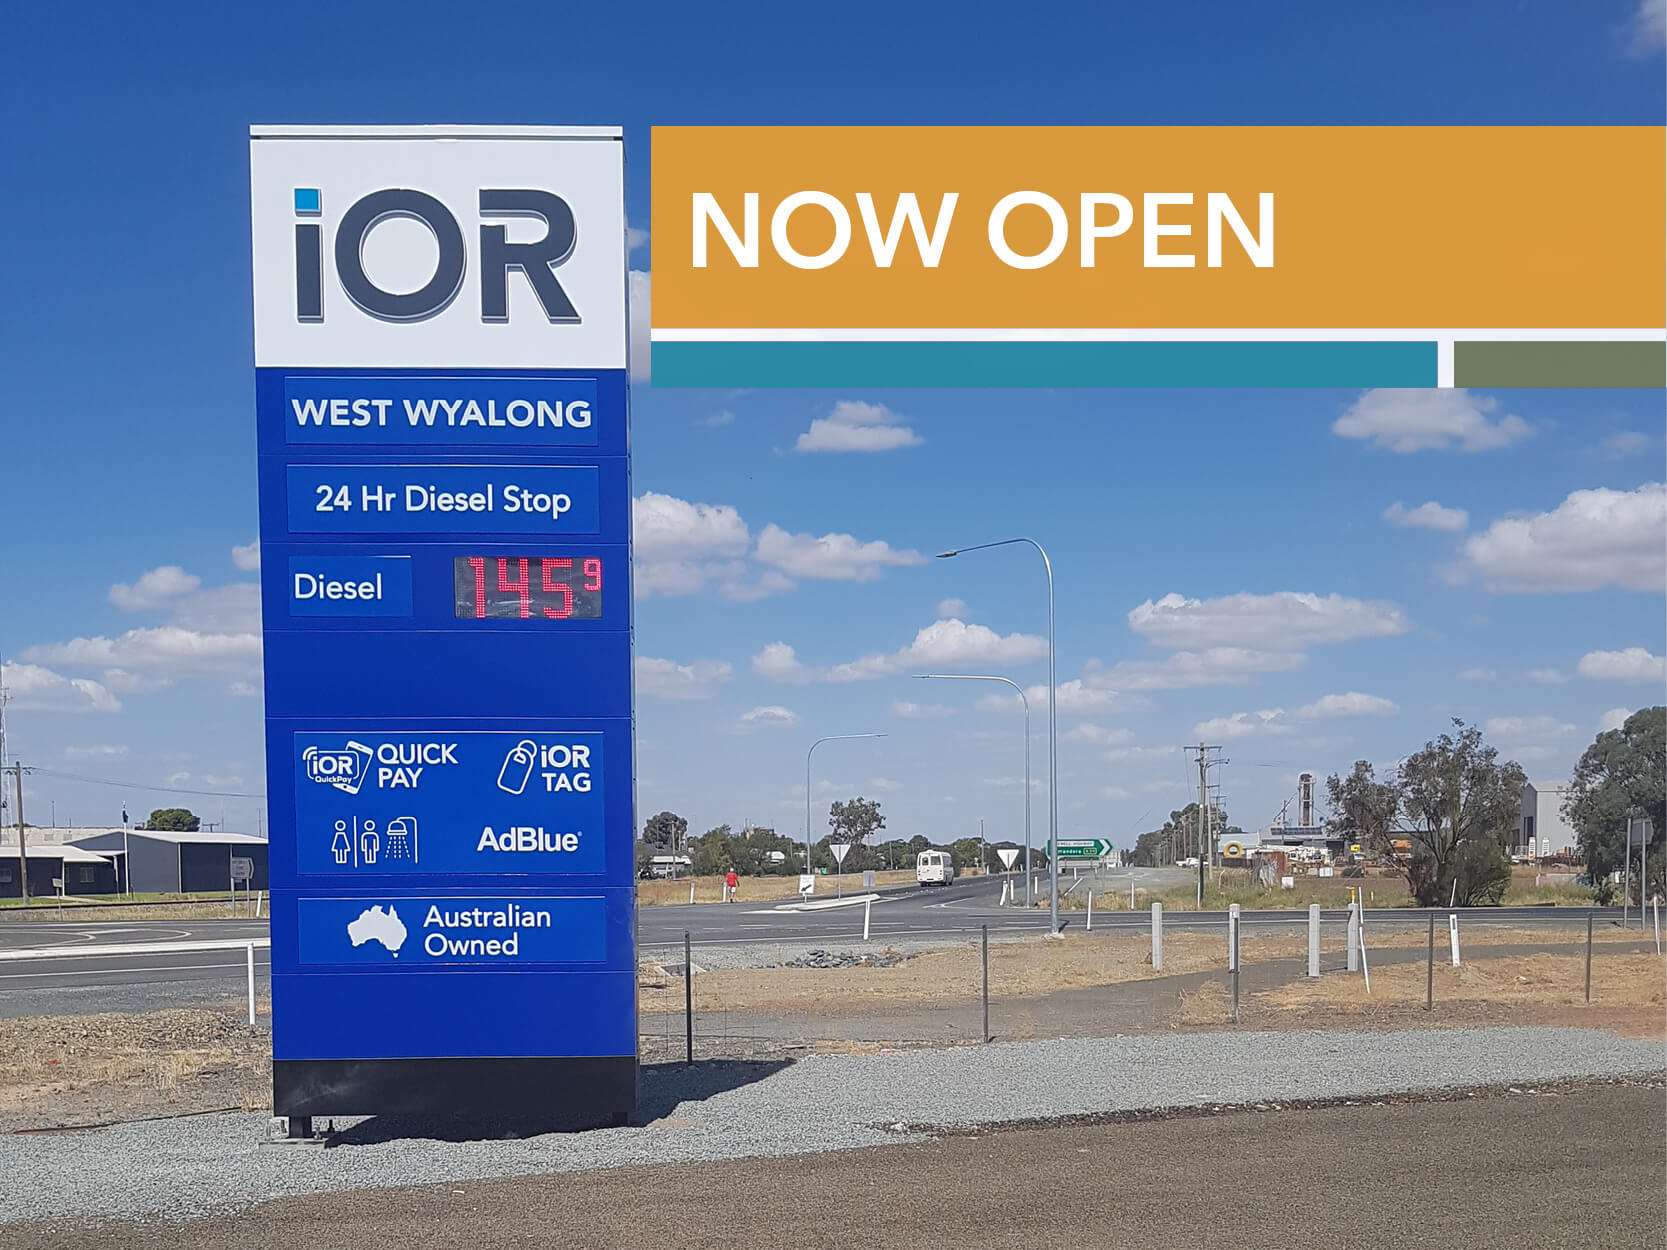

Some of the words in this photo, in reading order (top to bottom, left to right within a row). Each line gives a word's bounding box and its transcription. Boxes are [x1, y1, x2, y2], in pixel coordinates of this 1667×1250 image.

[293, 186, 582, 325] iOR
[291, 398, 393, 427] WEST
[403, 399, 592, 428] WYALONG
[316, 485, 352, 512] 24
[362, 485, 396, 512] Hr
[405, 484, 493, 512] Diesel
[503, 485, 571, 520] Stop
[294, 573, 382, 600] Diesel
[312, 755, 354, 775] iOR
[377, 743, 459, 765] QUICK
[540, 744, 591, 768] iOR
[314, 775, 352, 784] QuickPay
[378, 767, 424, 788] PAY
[541, 772, 591, 792] TAG
[476, 827, 579, 852] AdBlue
[423, 904, 551, 928] Australian
[424, 932, 518, 956] Owned
